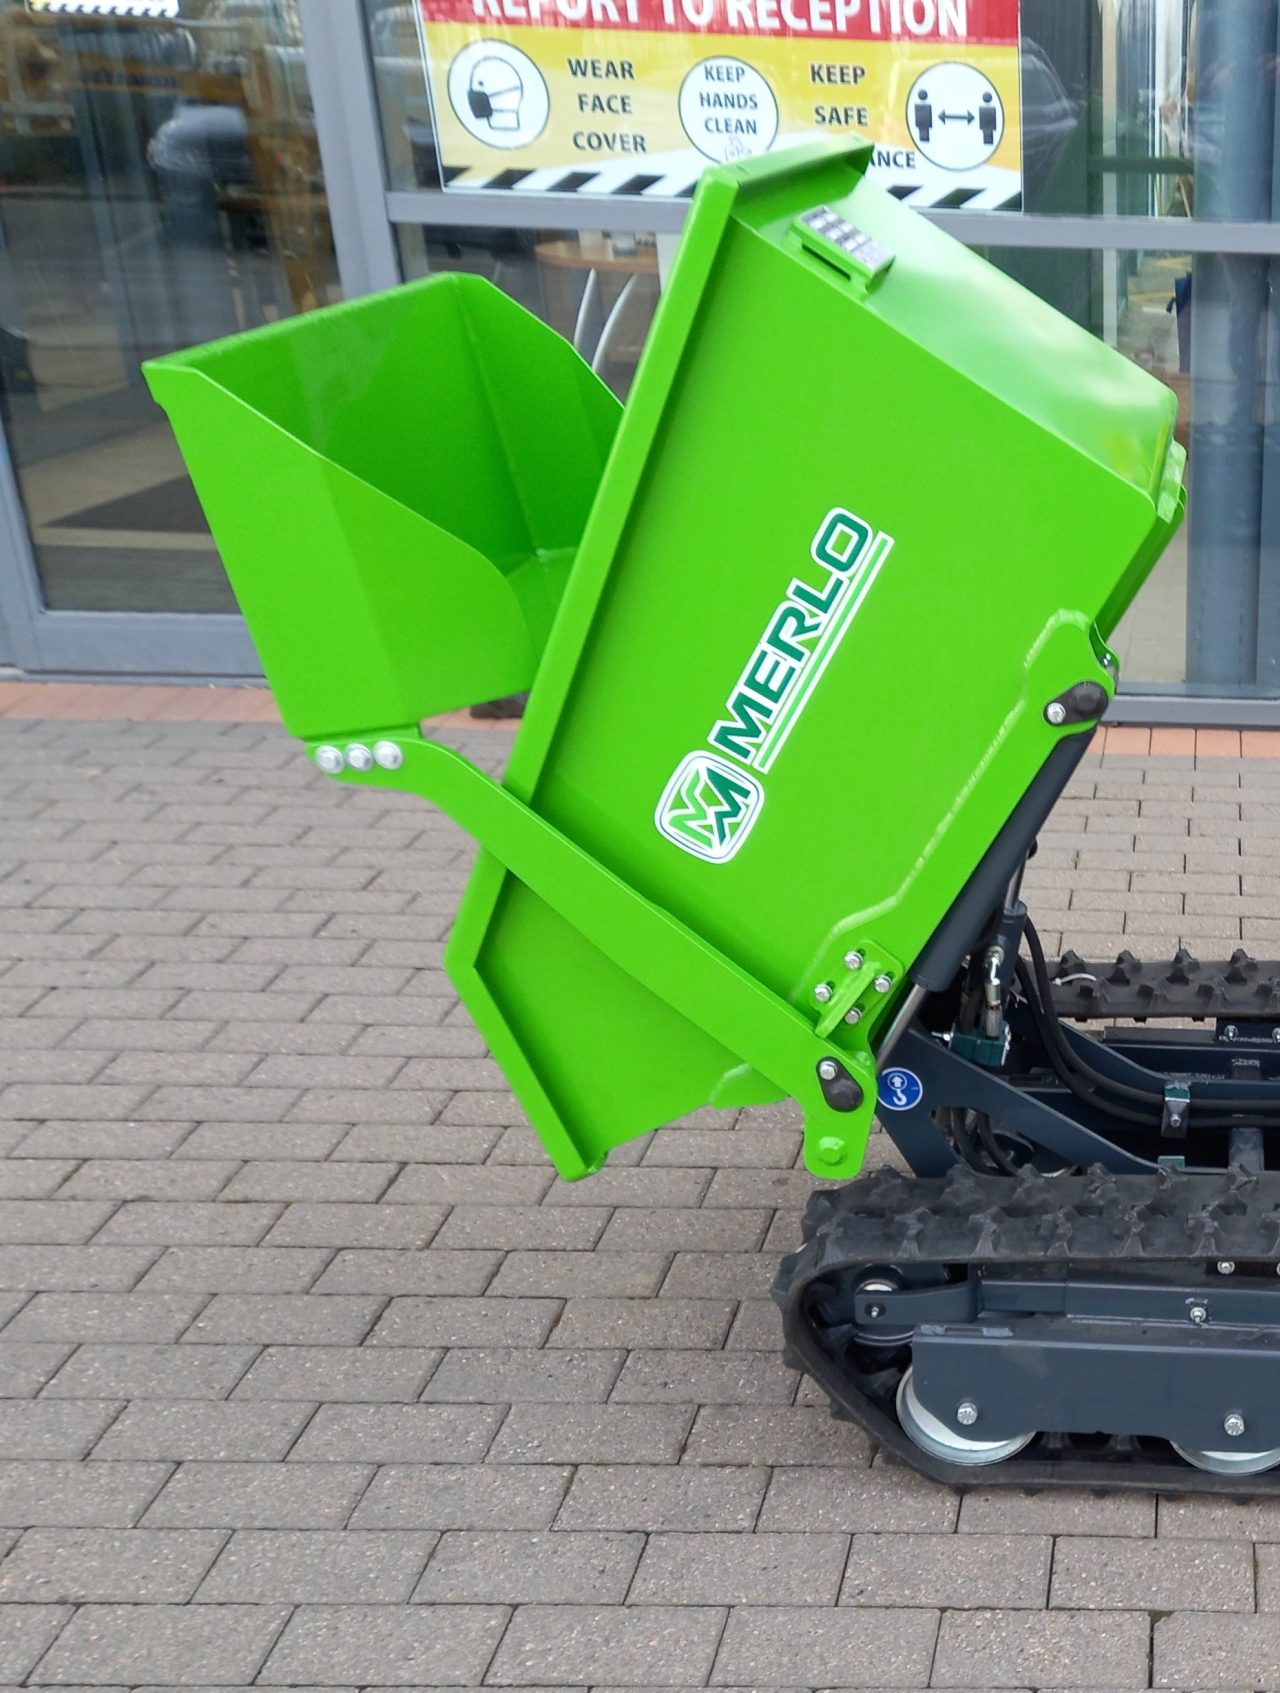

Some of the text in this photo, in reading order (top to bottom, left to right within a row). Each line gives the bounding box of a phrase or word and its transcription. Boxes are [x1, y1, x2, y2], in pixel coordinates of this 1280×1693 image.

[727, 0, 968, 37] RECEPTION
[567, 58, 634, 80] WEAR
[704, 64, 745, 83] KEEP
[810, 63, 865, 85] KEEP
[578, 93, 633, 115] FACE
[700, 91, 758, 110] HANDS
[704, 116, 757, 135] CLEAN
[815, 105, 868, 127] SAFE
[572, 130, 647, 153] COVER
[870, 150, 916, 169] NCE
[710, 510, 871, 762] MERLO
